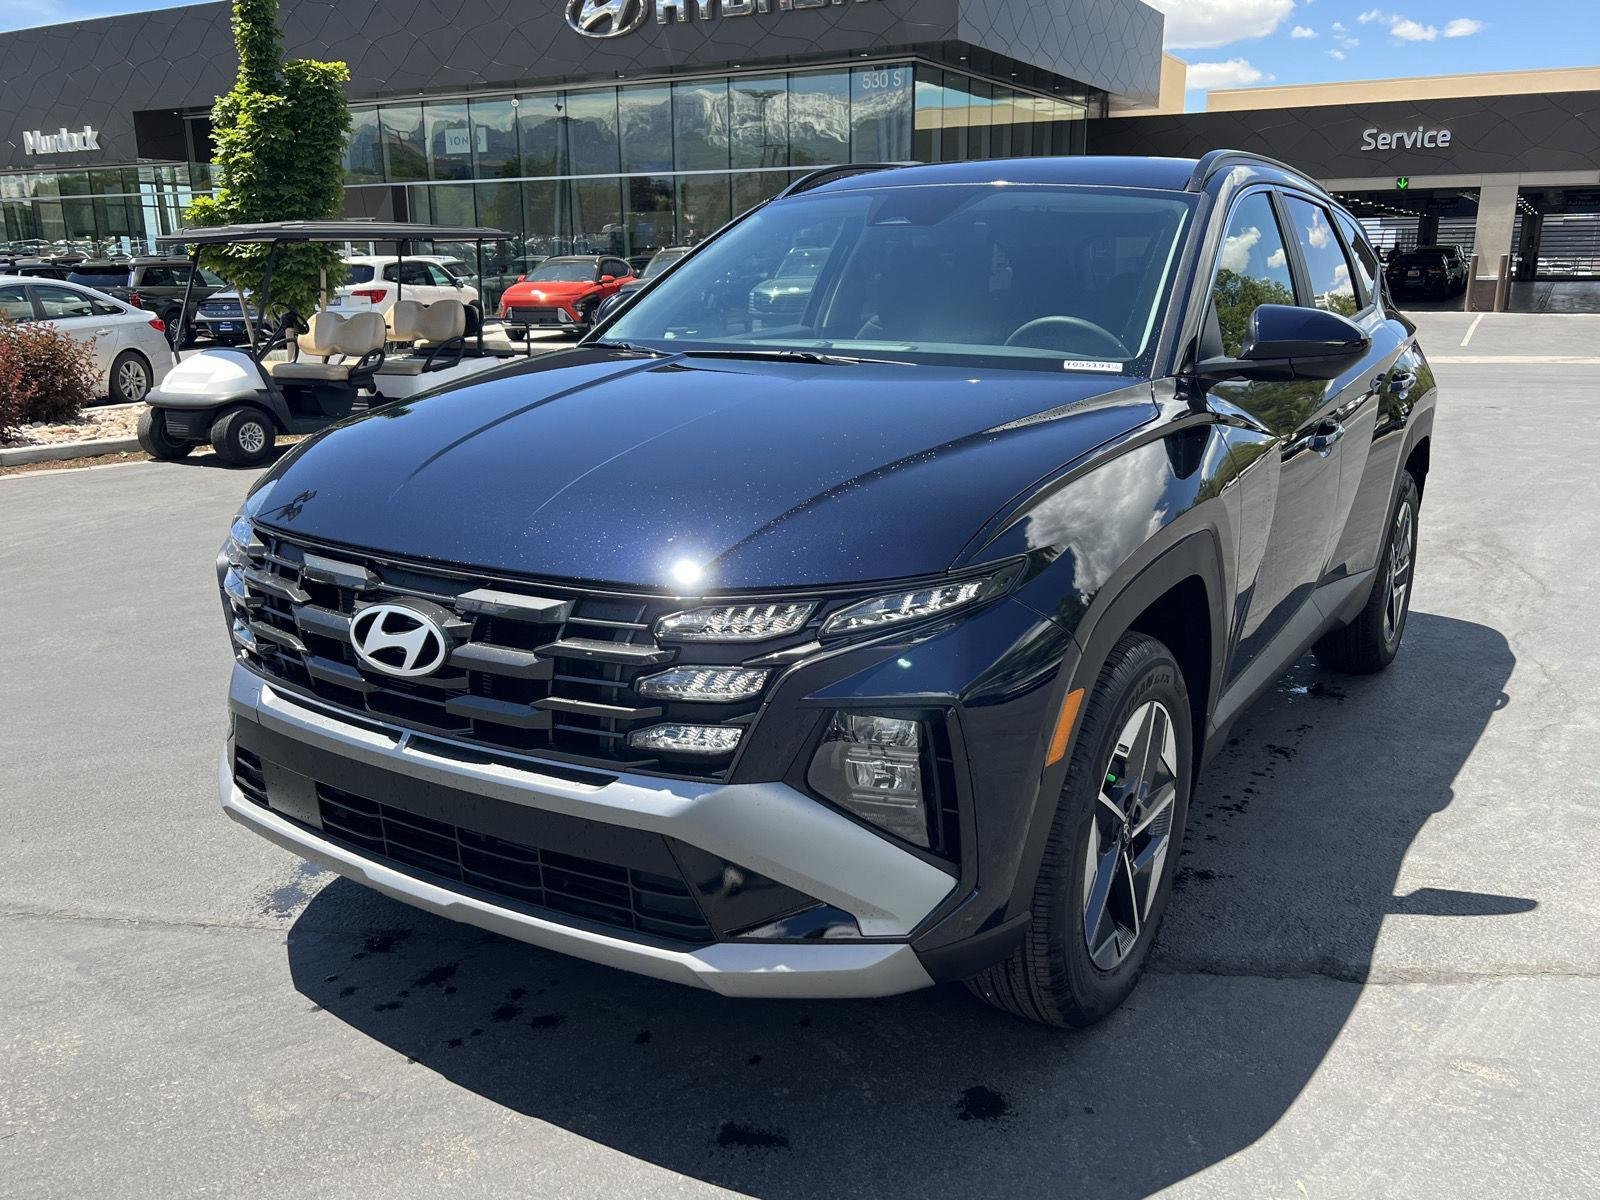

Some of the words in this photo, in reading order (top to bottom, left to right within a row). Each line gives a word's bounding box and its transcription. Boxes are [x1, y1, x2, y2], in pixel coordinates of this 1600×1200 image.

[862, 72, 889, 89] 530
[893, 70, 902, 87] S
[22, 125, 101, 155] Murdock
[1360, 126, 1452, 151] Service
